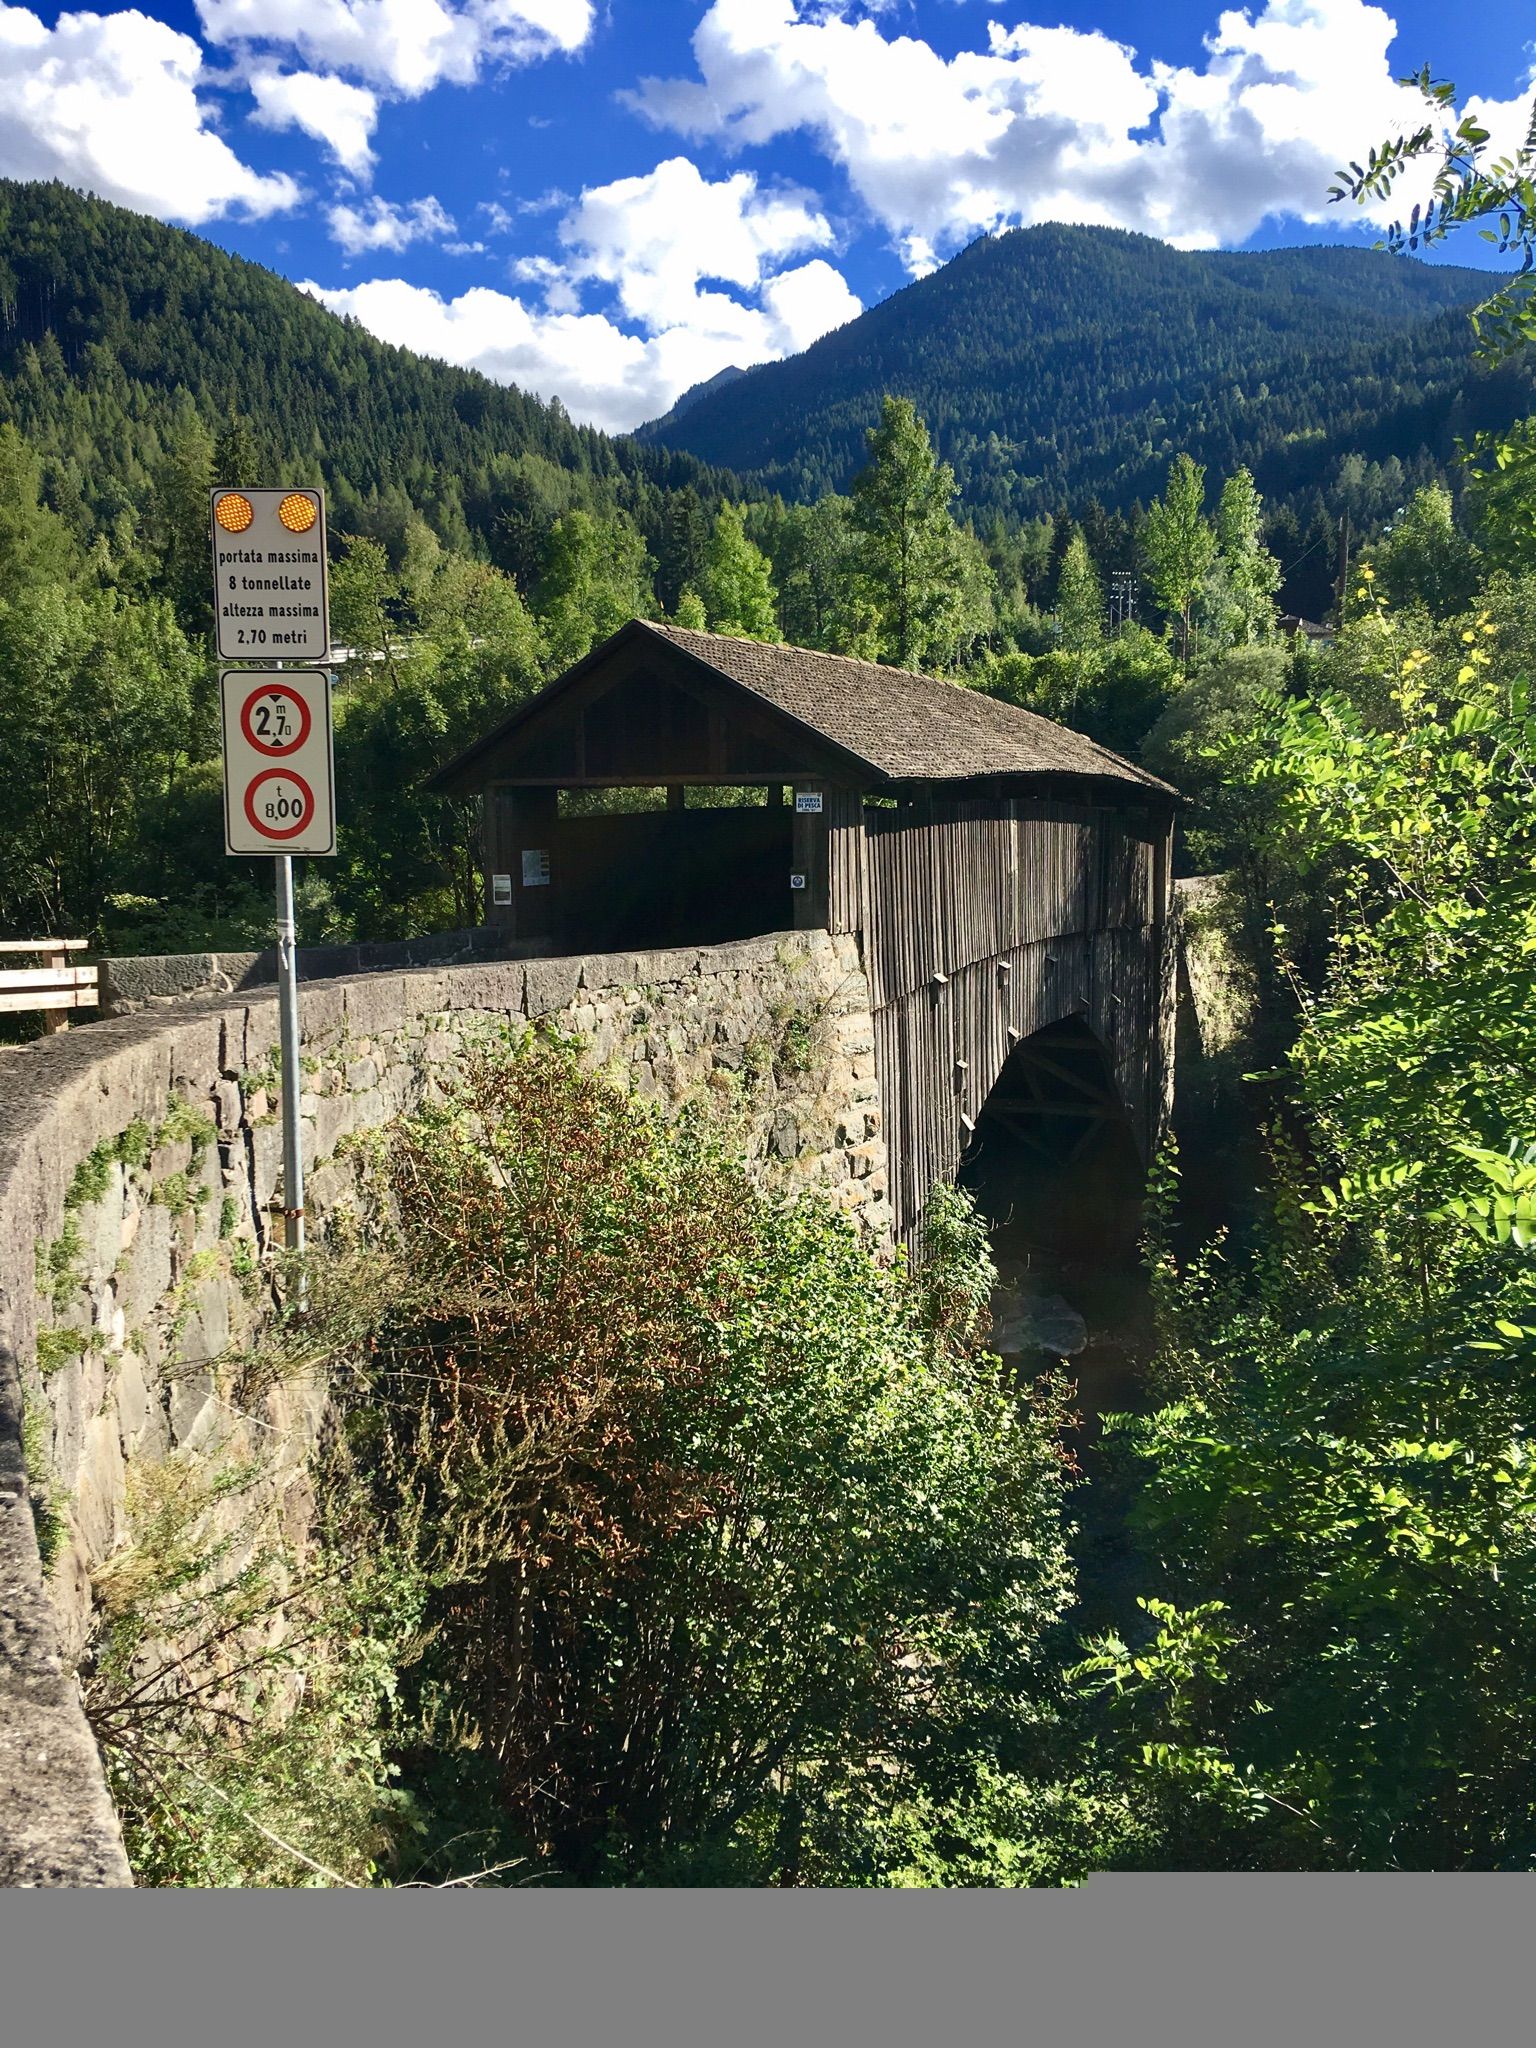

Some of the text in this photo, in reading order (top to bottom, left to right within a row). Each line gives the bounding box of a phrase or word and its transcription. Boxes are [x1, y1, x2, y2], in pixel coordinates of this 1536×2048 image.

[219, 549, 318, 566] portata massima
[229, 575, 311, 590] 8 tonnellate
[222, 603, 319, 617] altezza massima
[237, 629, 307, 645] 2,70 metri
[276, 705, 286, 714] m
[255, 706, 292, 738] 2,70
[276, 785, 282, 797] t
[265, 798, 303, 821] 8,00
